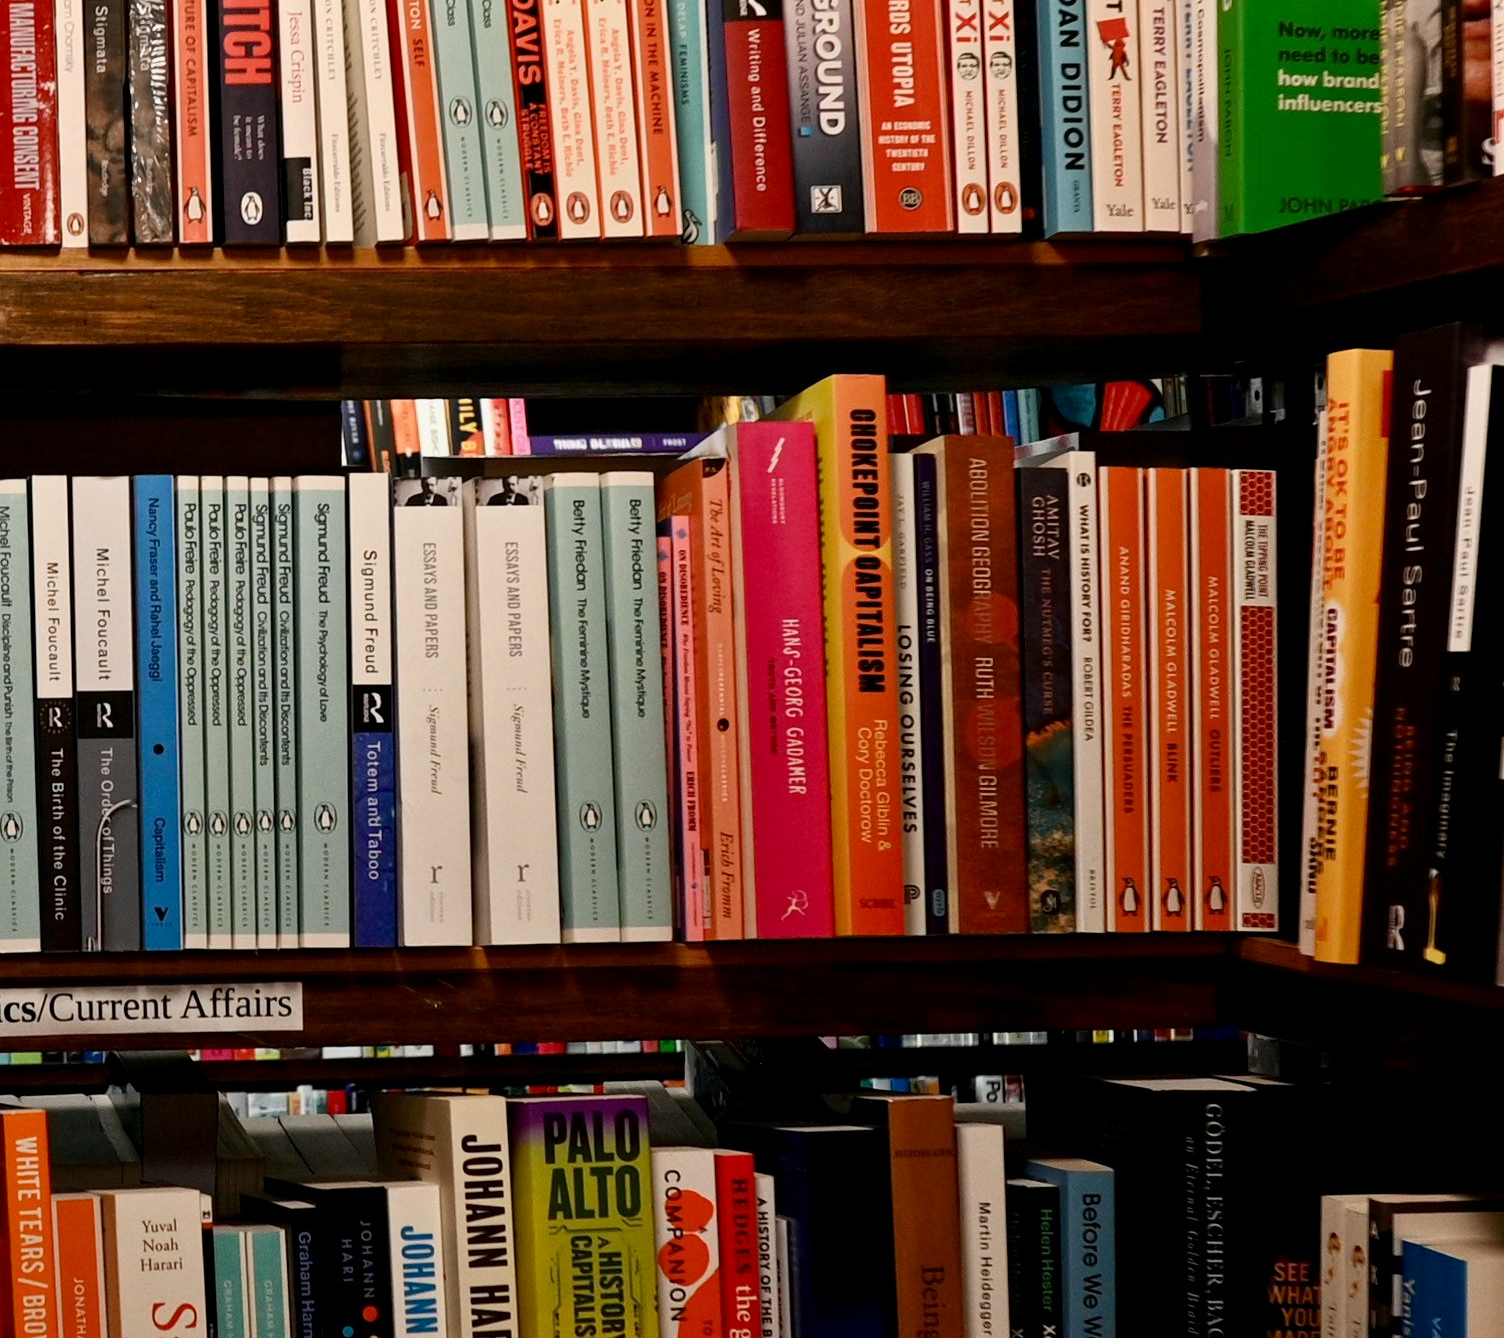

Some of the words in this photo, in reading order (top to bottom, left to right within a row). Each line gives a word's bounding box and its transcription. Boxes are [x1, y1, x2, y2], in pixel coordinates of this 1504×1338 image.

[1060, 63, 1085, 171] DIDION
[93, 547, 112, 605] Michel
[96, 609, 114, 681] Foucault
[180, 988, 292, 1020] Affairs
[543, 1109, 641, 1164] PALO
[548, 1166, 644, 1221] ALTO
